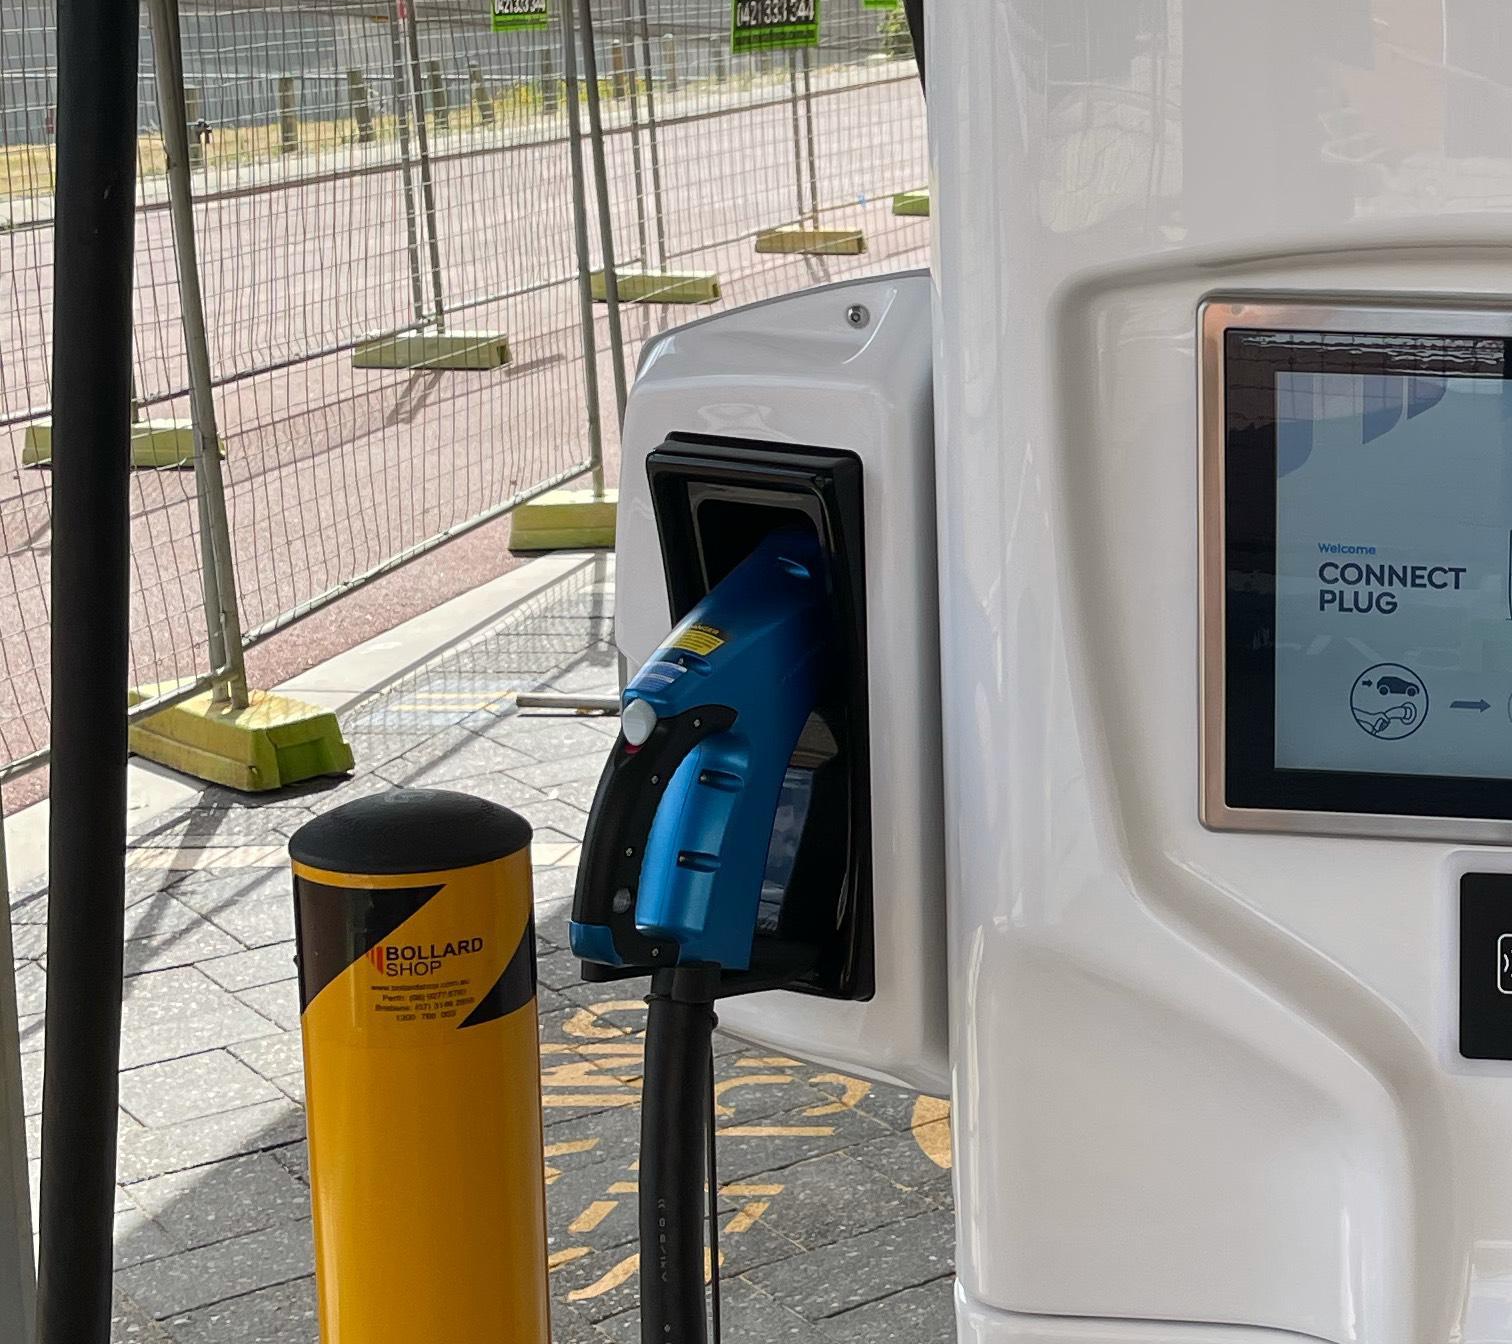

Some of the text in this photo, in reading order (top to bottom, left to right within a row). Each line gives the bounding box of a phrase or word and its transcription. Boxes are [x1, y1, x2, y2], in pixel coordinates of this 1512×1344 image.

[1317, 542, 1377, 555] Welcome
[1318, 561, 1467, 590] CONNECT
[1319, 589, 1399, 615] PLUG
[385, 937, 484, 961] BOLLARD
[385, 960, 442, 977] SHOP
